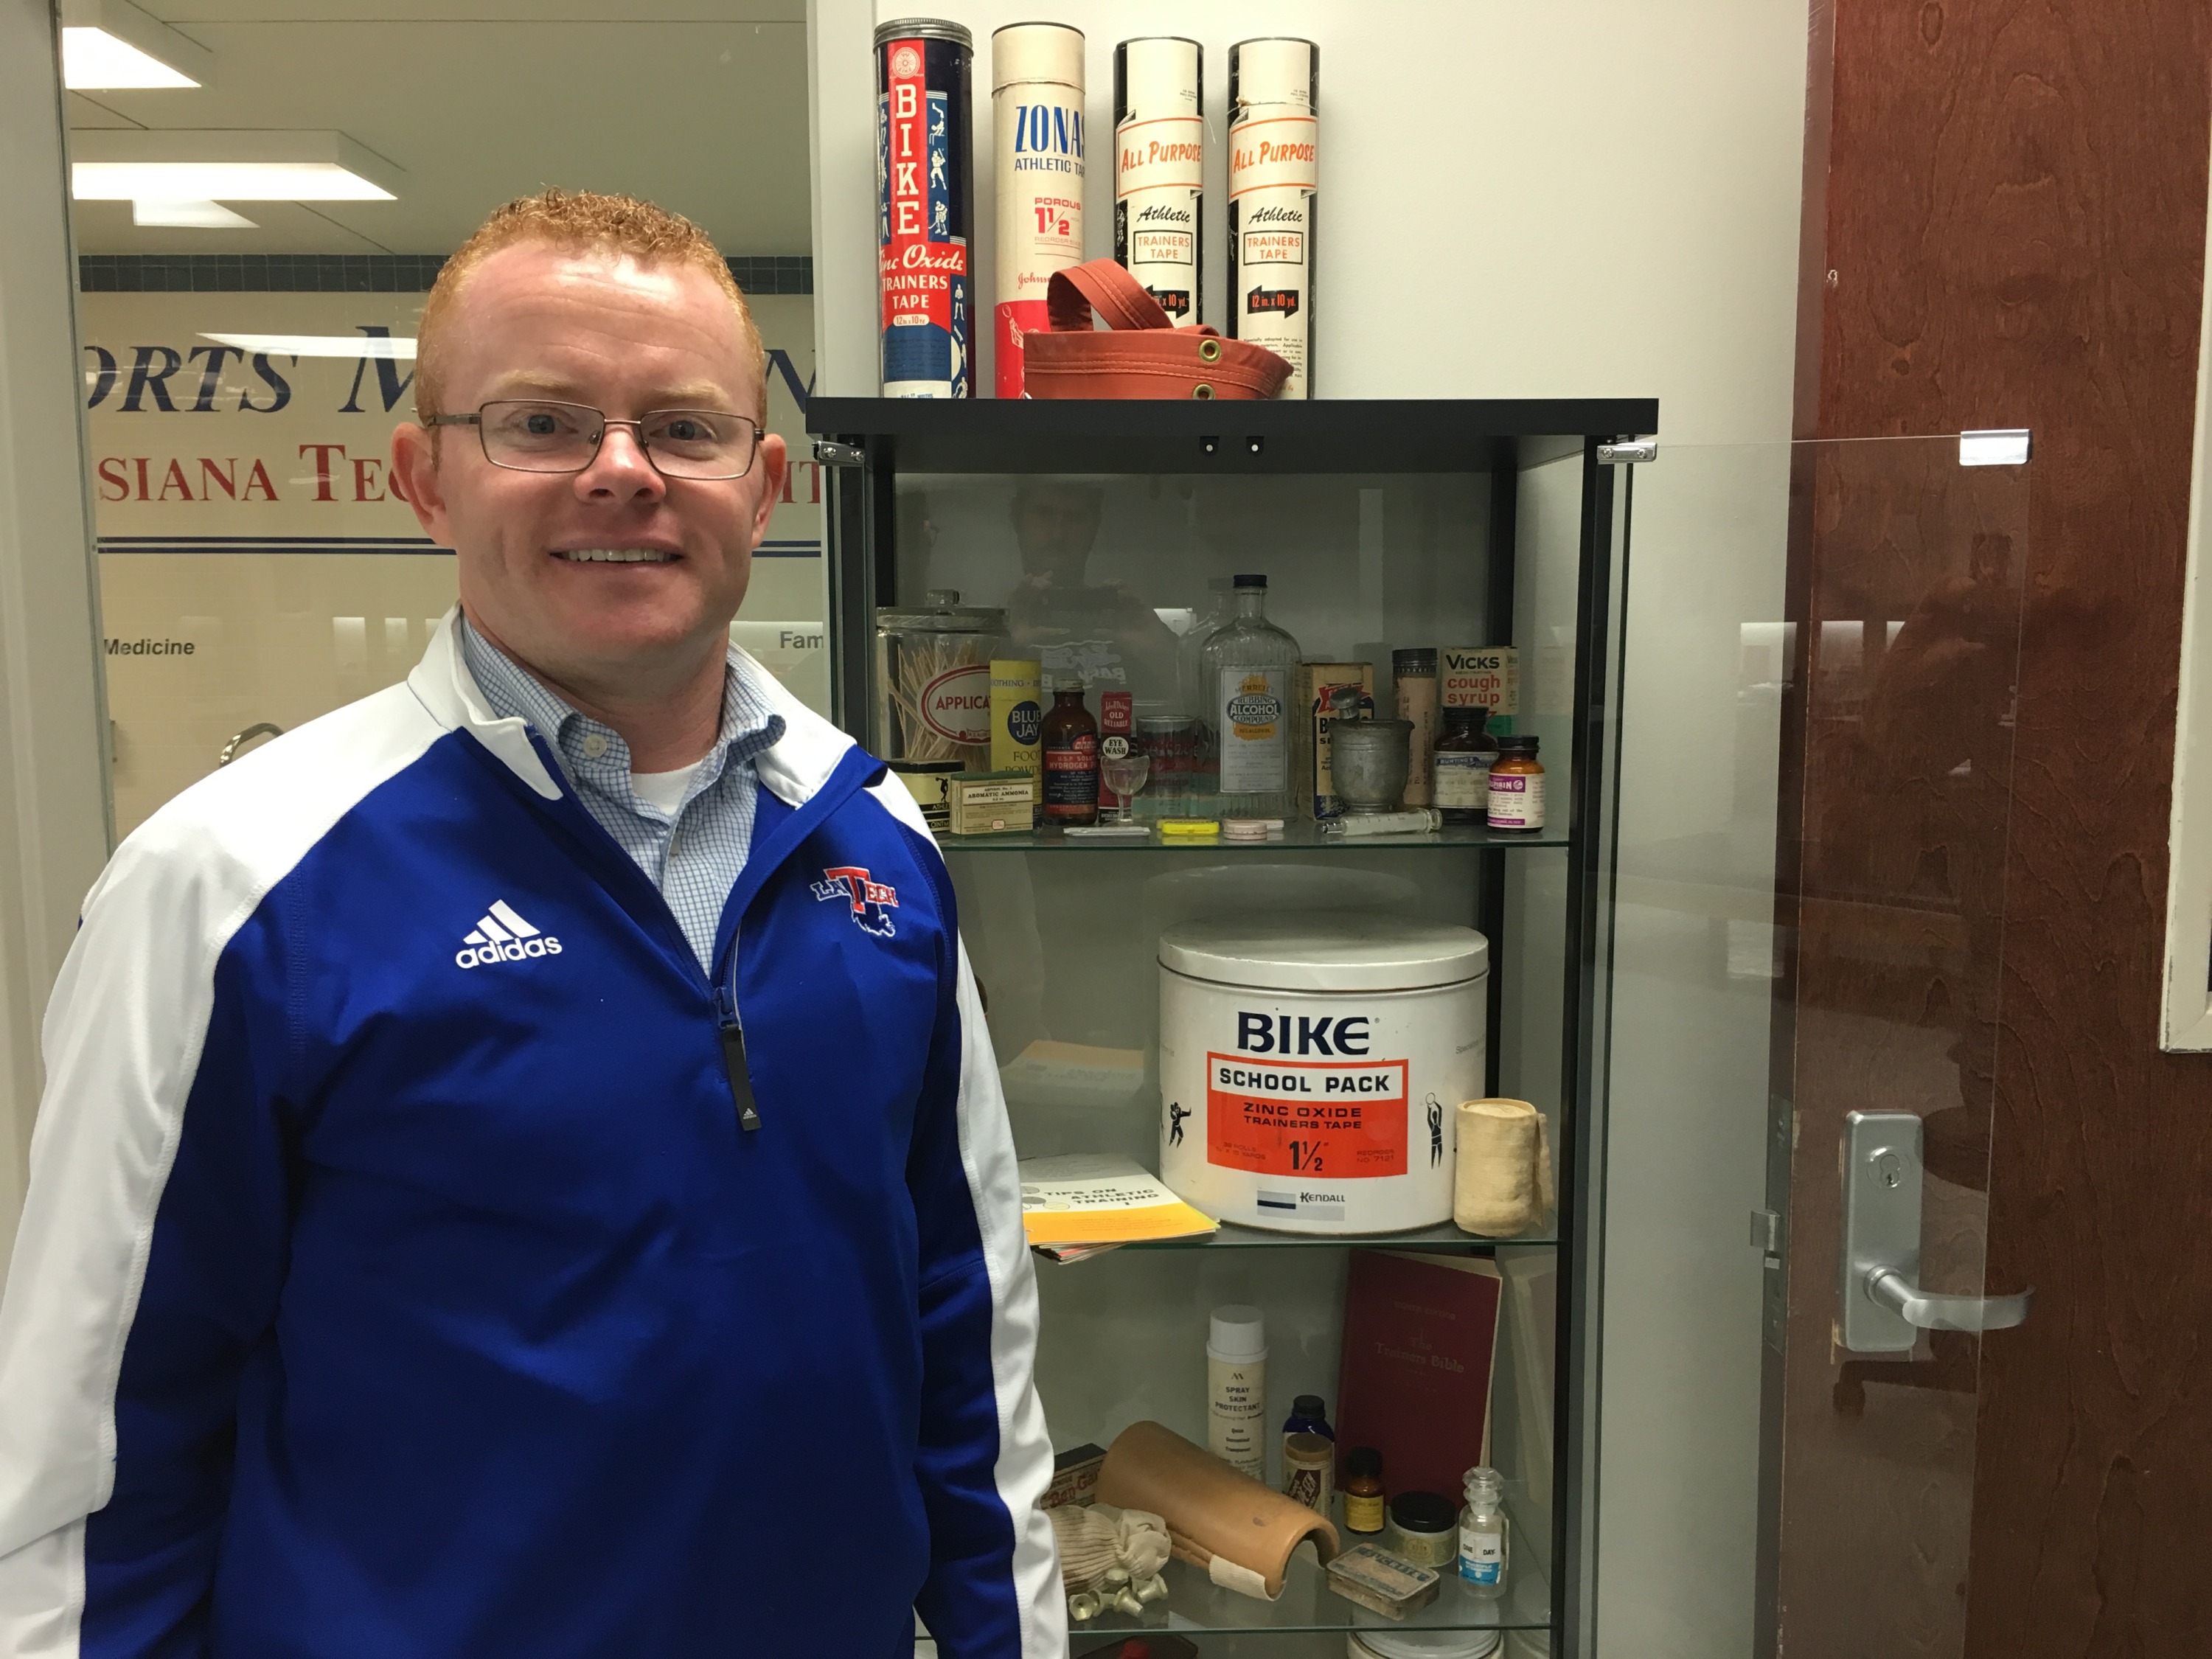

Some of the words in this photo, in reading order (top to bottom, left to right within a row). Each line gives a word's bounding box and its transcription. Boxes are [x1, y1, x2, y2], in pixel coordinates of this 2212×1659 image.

[895, 83, 920, 234] BIKE
[1121, 148, 1144, 173] ALL
[1149, 141, 1201, 164] PURPOSE
[1234, 148, 1255, 173] ALL
[1259, 141, 1315, 164] PURPOSE
[1015, 158, 1071, 173] ATHLETIC
[1034, 197, 1081, 211] POROUS
[1136, 205, 1191, 223] Athletic
[1248, 206, 1303, 225] Athletic
[1138, 235, 1190, 248] TRAINERS
[1247, 236, 1301, 248] TRAINERS
[902, 244, 964, 271] Oxide
[1150, 248, 1178, 259] TAPE
[1259, 249, 1288, 260] TAPE
[882, 275, 948, 292] TRAINERS
[892, 295, 930, 309] TAPE
[1169, 293, 1177, 307] 10
[1252, 295, 1260, 307] 12
[1270, 298, 1276, 307] x
[1277, 293, 1285, 307] 10
[103, 638, 195, 655] Medicine
[780, 631, 824, 649] Fam
[1446, 654, 1500, 669] VICKS
[1447, 674, 1500, 692] cough
[936, 695, 991, 711] APPLICA
[1447, 693, 1500, 707] syrup
[1012, 710, 1041, 723] BLUE
[1230, 703, 1279, 717] ALCOHOL
[1016, 723, 1040, 738] JAY
[1105, 746, 1126, 754] WASH
[455, 933, 564, 969] adidas
[1237, 1011, 1370, 1056] BIKE
[1220, 1067, 1312, 1093] SCHOOL
[1325, 1074, 1390, 1093] PACK
[1243, 1102, 1289, 1116] ZINC
[1296, 1106, 1362, 1118] OXIDE
[1244, 1115, 1320, 1129] TRAINERS
[1324, 1120, 1362, 1130] TAPE
[1071, 1189, 1155, 1200] ATHLETIC
[1074, 1193, 1160, 1204] TRAINING
[1430, 1354, 1465, 1374] Bible
[1215, 1401, 1260, 1412] PROTECTANT
